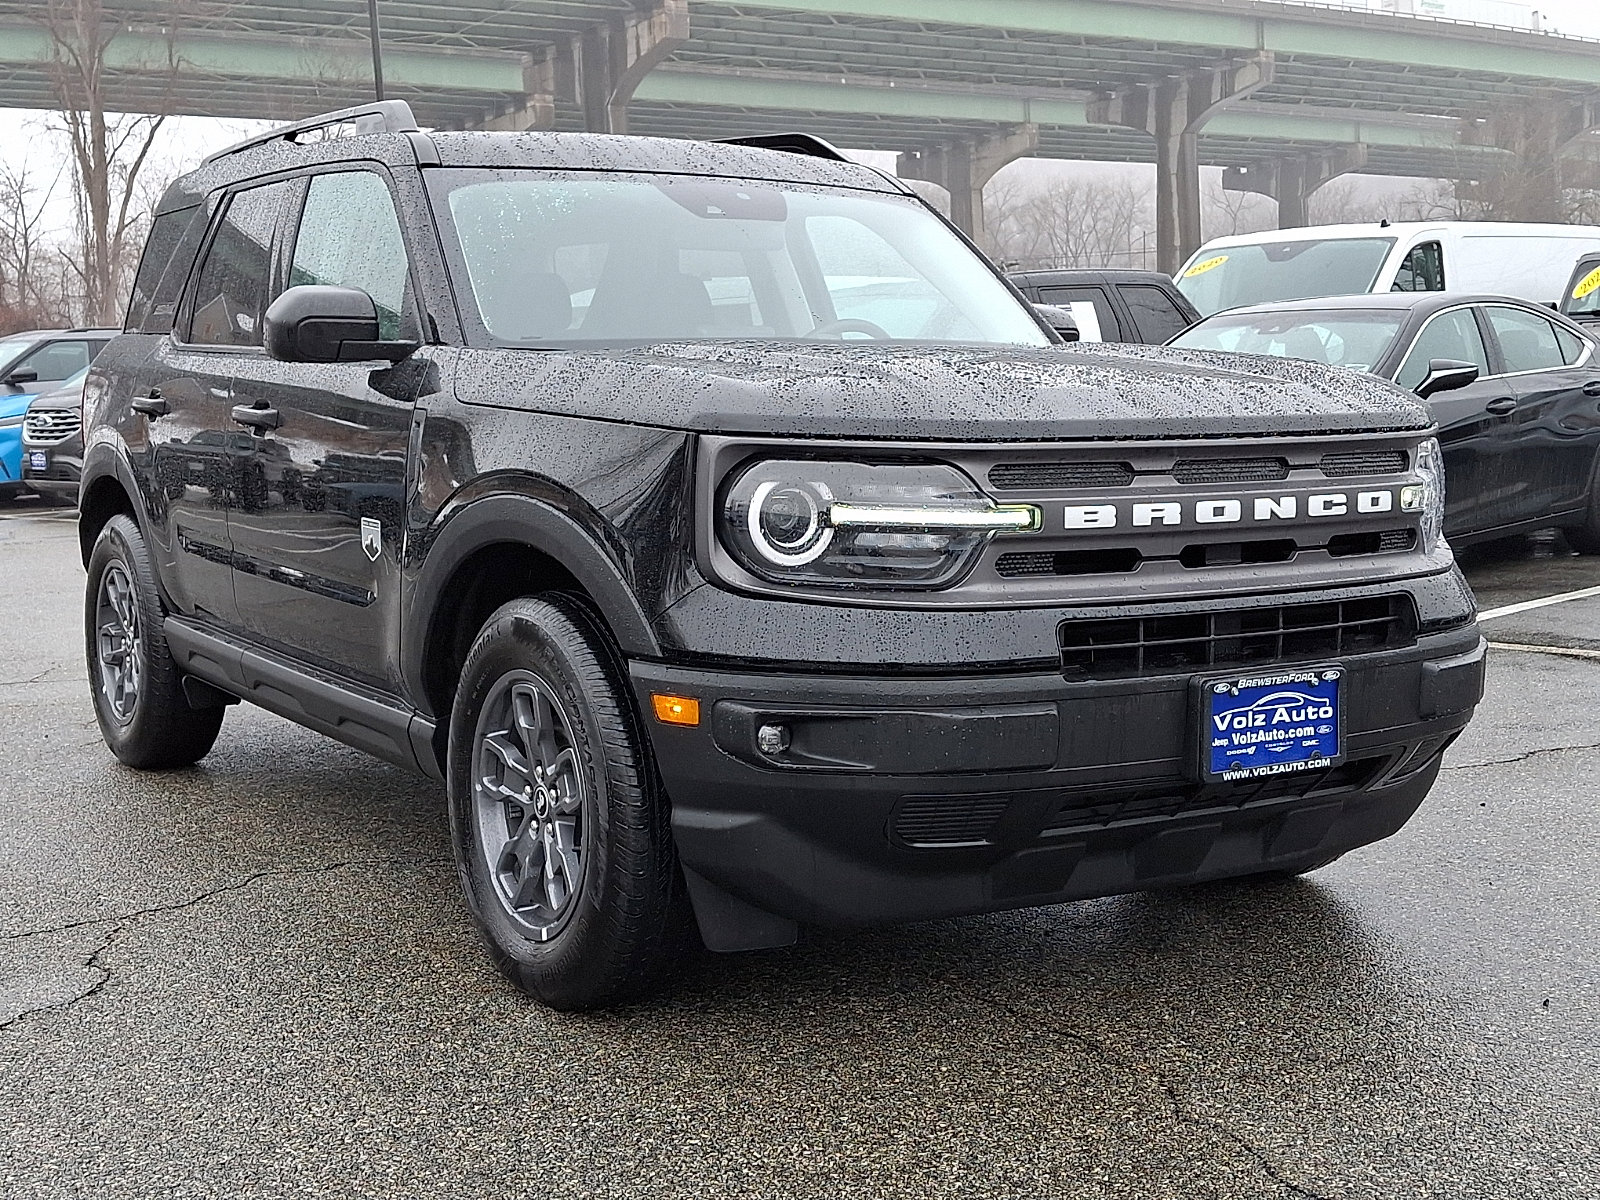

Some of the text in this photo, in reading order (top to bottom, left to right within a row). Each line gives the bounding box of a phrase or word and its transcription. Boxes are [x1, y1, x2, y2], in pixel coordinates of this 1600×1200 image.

[1191, 257, 1223, 273] 2020
[1064, 491, 1393, 529] BRONCO
[1213, 705, 1333, 731] Volz Auto
[1232, 726, 1315, 745] VolzAuto.com
[1223, 758, 1331, 782] WWW.VOLZAUTO.COM
